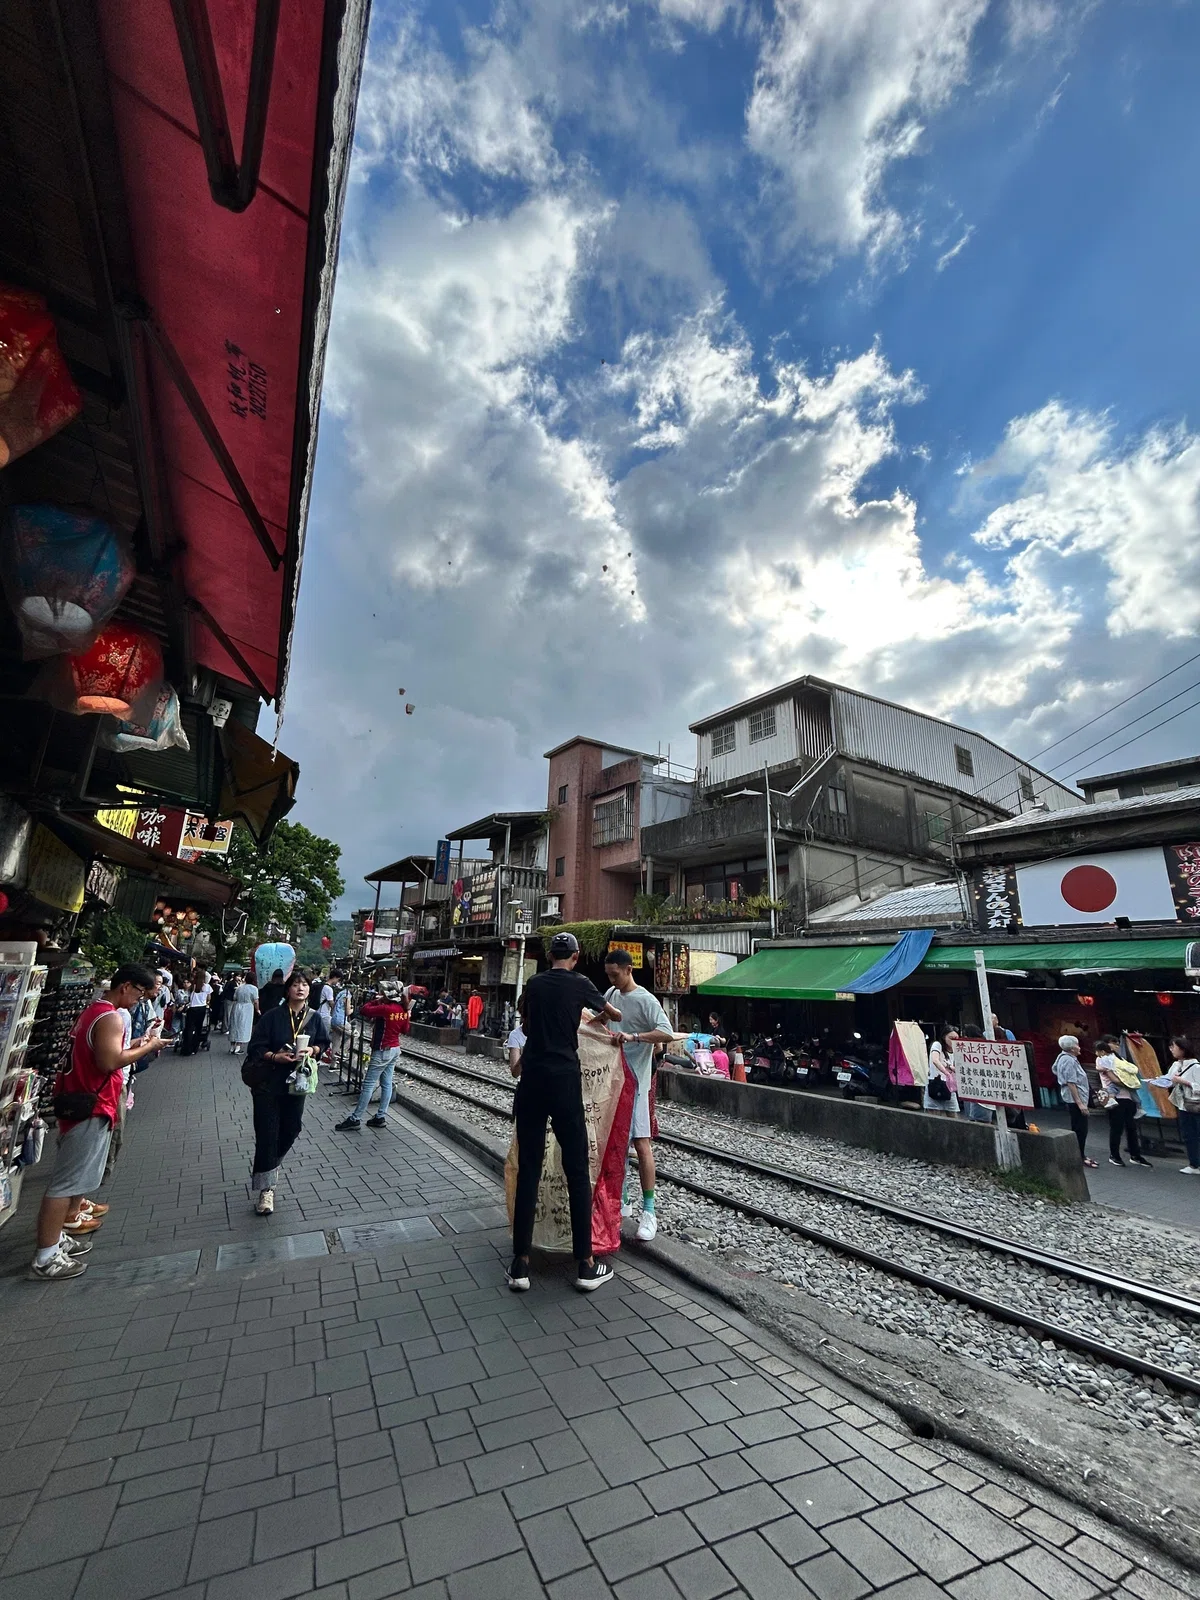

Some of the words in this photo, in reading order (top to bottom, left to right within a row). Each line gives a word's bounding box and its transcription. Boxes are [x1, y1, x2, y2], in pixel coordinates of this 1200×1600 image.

[136, 808, 166, 848] 咖啡
[956, 1042, 1021, 1057] 禁止行人通行
[963, 1054, 979, 1064] No
[983, 1056, 1013, 1069] Entry
